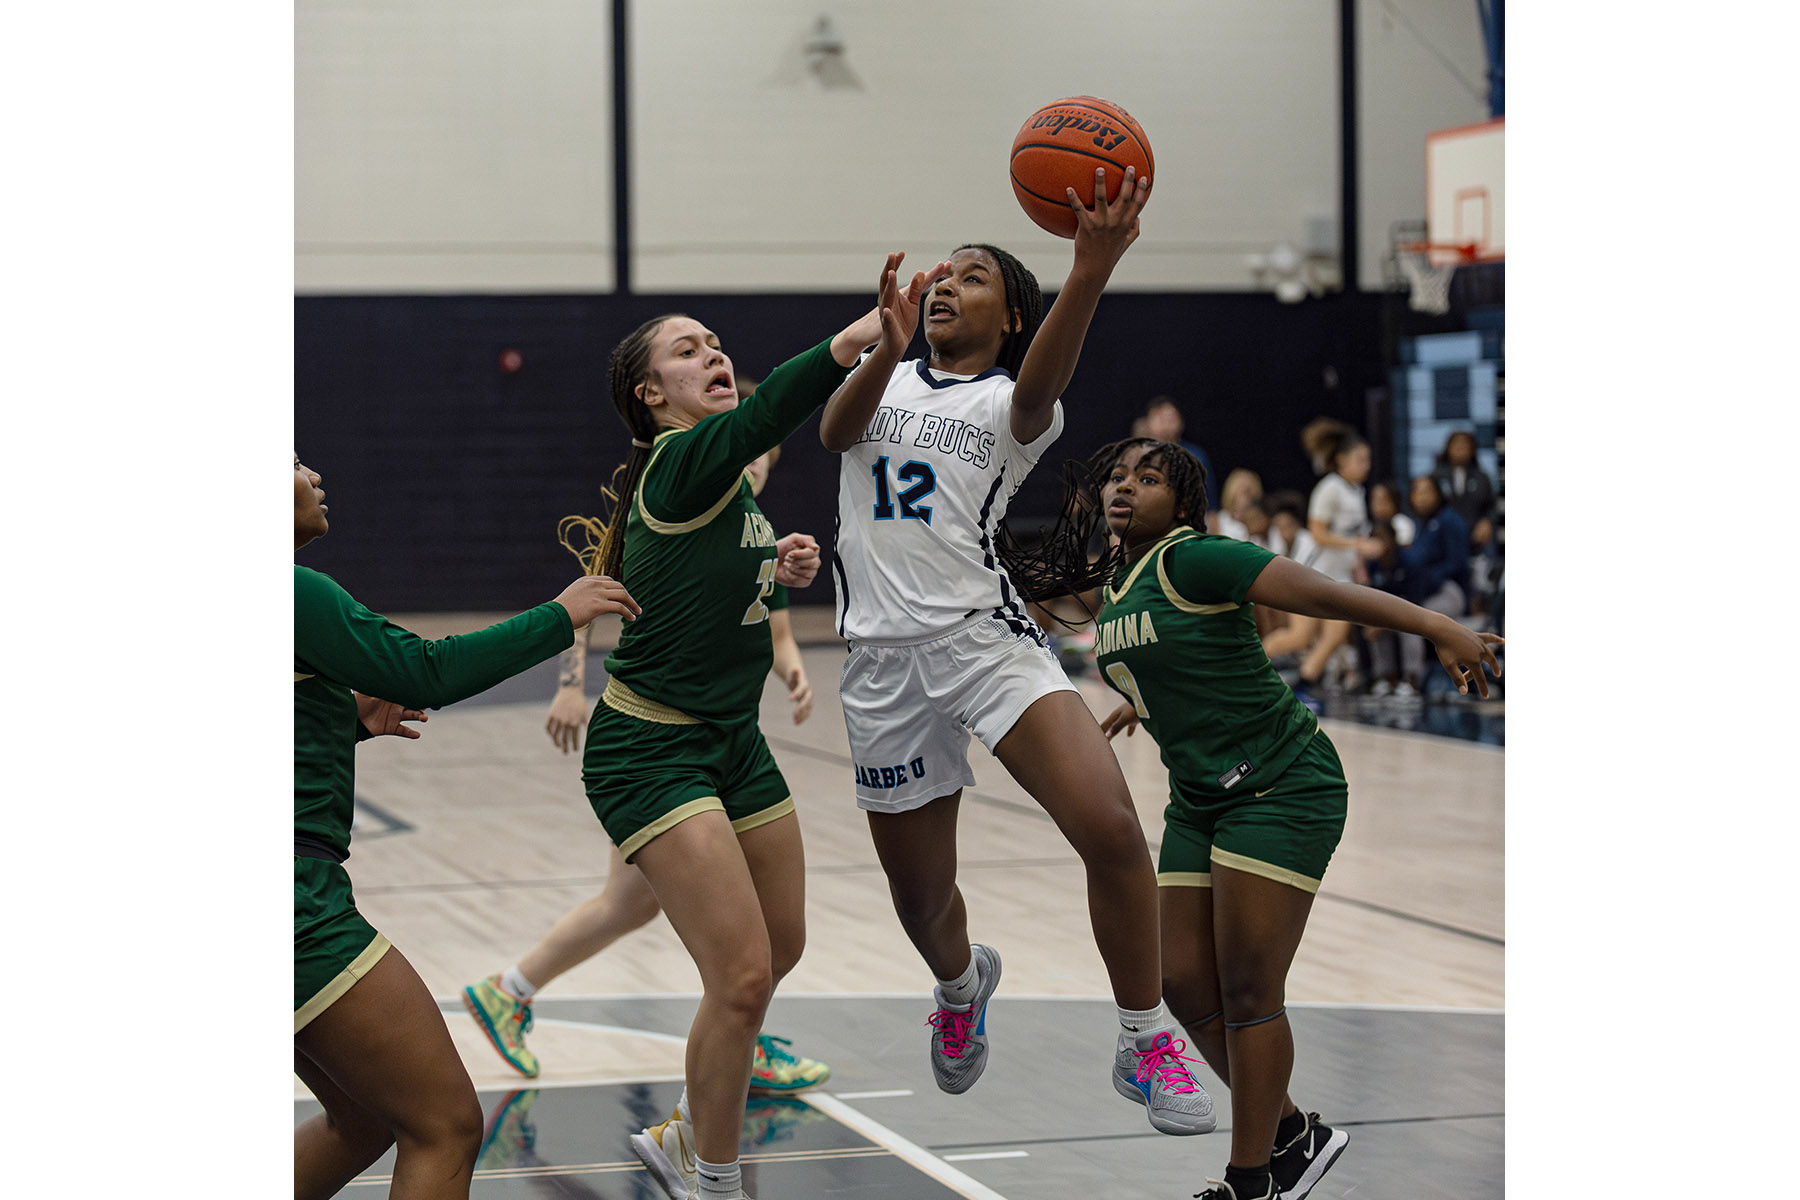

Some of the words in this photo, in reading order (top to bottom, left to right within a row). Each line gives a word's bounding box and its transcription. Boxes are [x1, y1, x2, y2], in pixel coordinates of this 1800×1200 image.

[1031, 114, 1127, 151] Baden
[855, 406, 916, 444] DY
[914, 414, 995, 469] BUCS
[872, 456, 937, 526] 12
[909, 756, 926, 779] U
